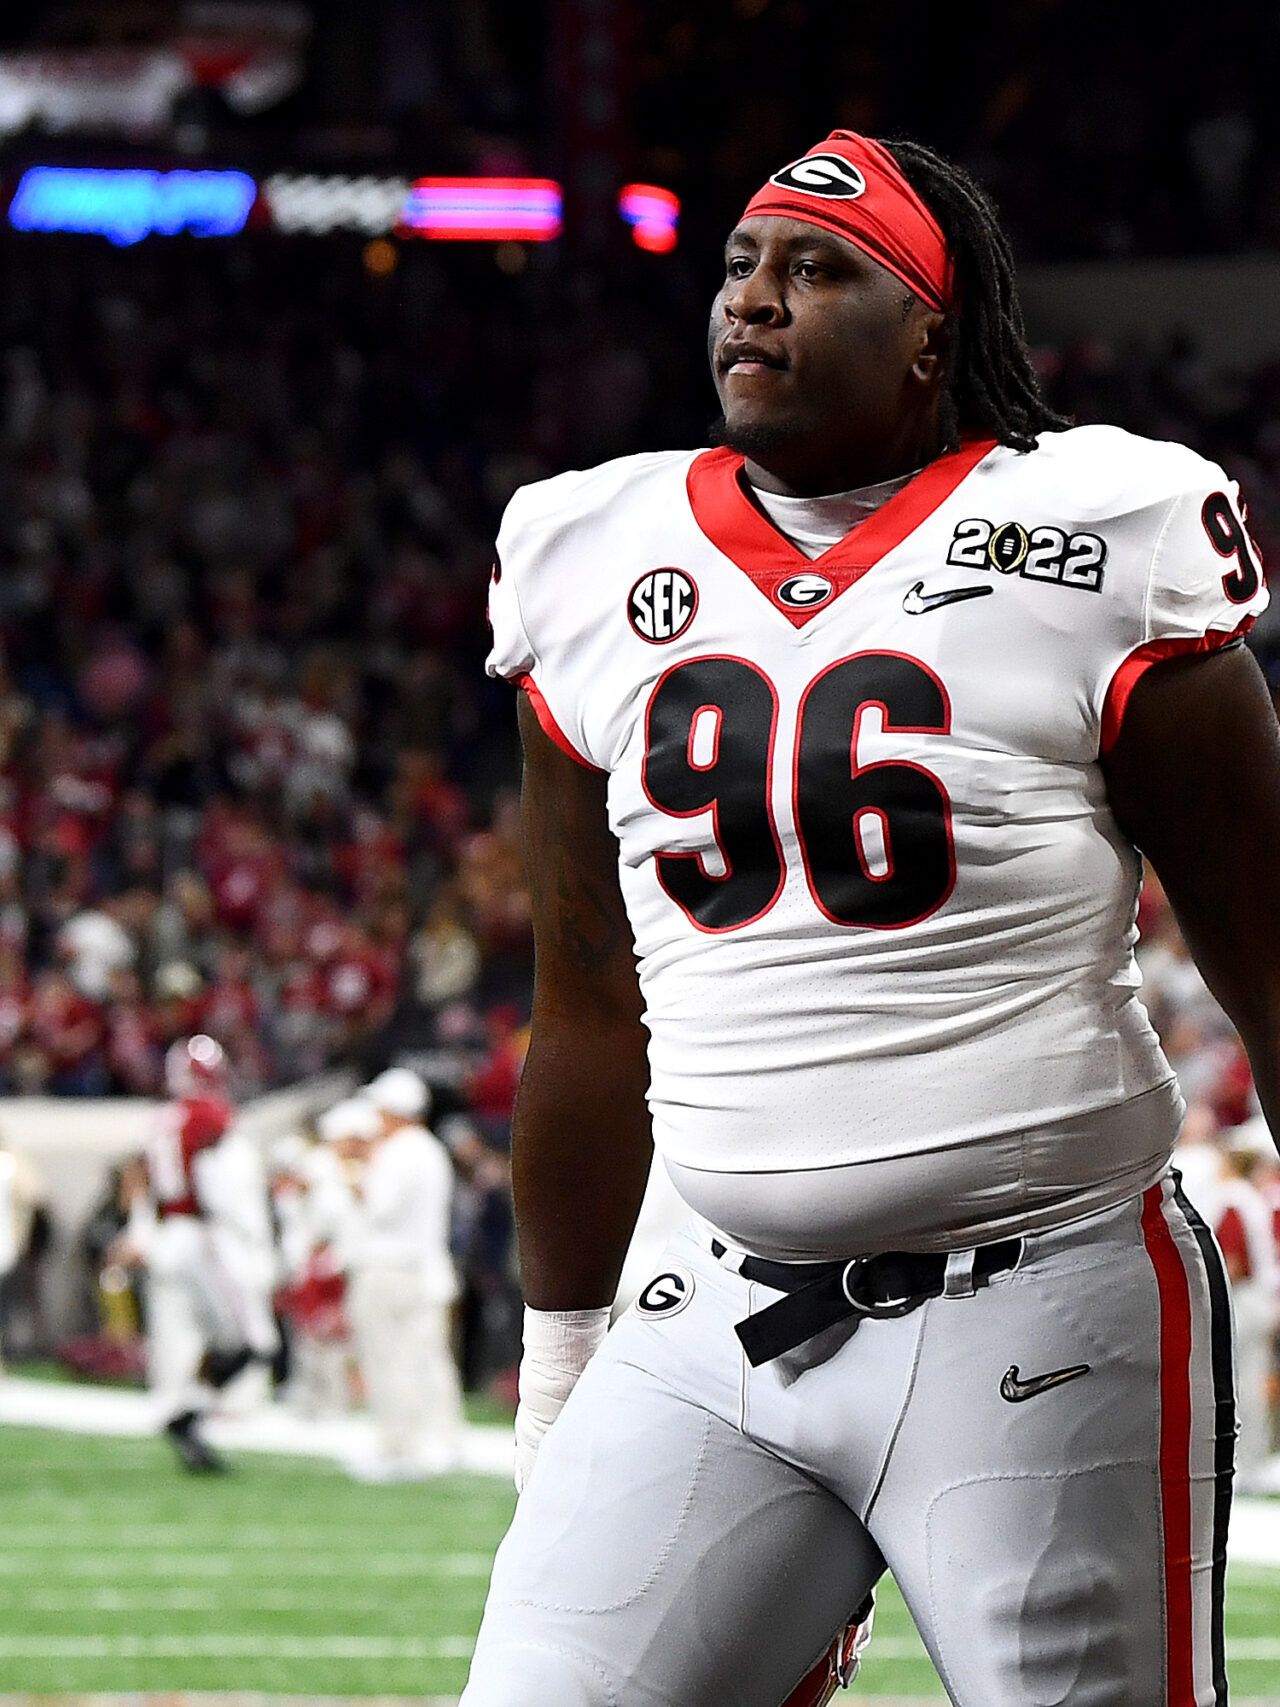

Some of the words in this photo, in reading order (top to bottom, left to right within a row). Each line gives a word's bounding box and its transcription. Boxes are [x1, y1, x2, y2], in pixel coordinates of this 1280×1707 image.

[774, 156, 862, 195] G
[1201, 491, 1267, 604] 9
[631, 571, 693, 639] SEC
[778, 574, 832, 607] G
[641, 649, 957, 934] 96
[638, 1272, 686, 1312] G
